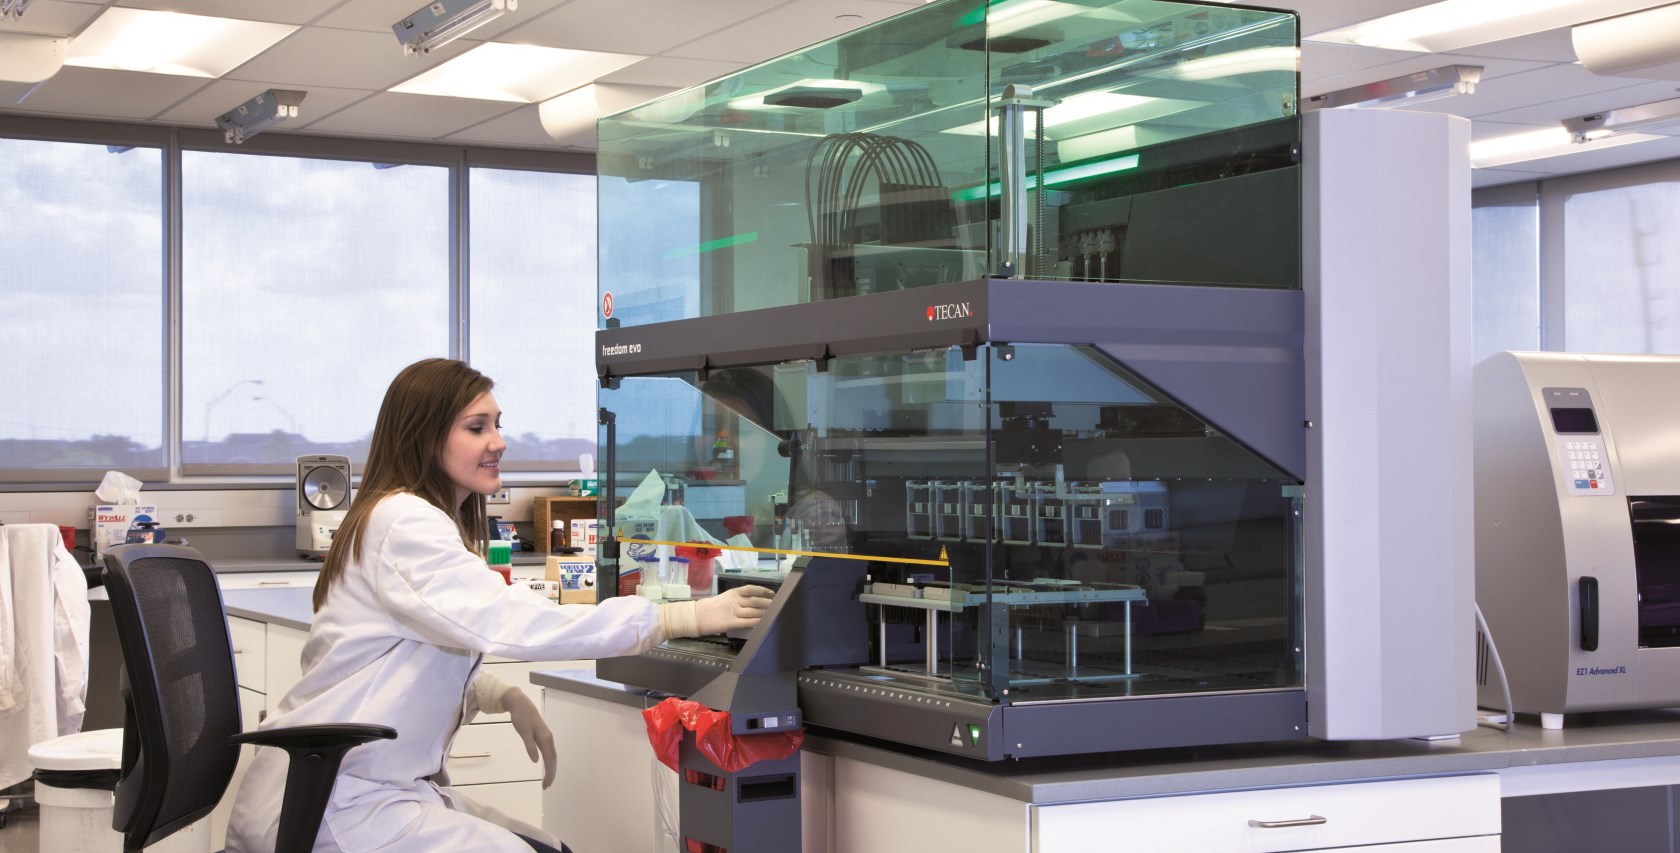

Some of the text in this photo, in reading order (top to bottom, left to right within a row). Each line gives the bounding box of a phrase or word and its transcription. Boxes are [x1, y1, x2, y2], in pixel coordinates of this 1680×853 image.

[602, 342, 642, 357] freedom evo
[1576, 665, 1626, 676] EZ1 Advanced XL
